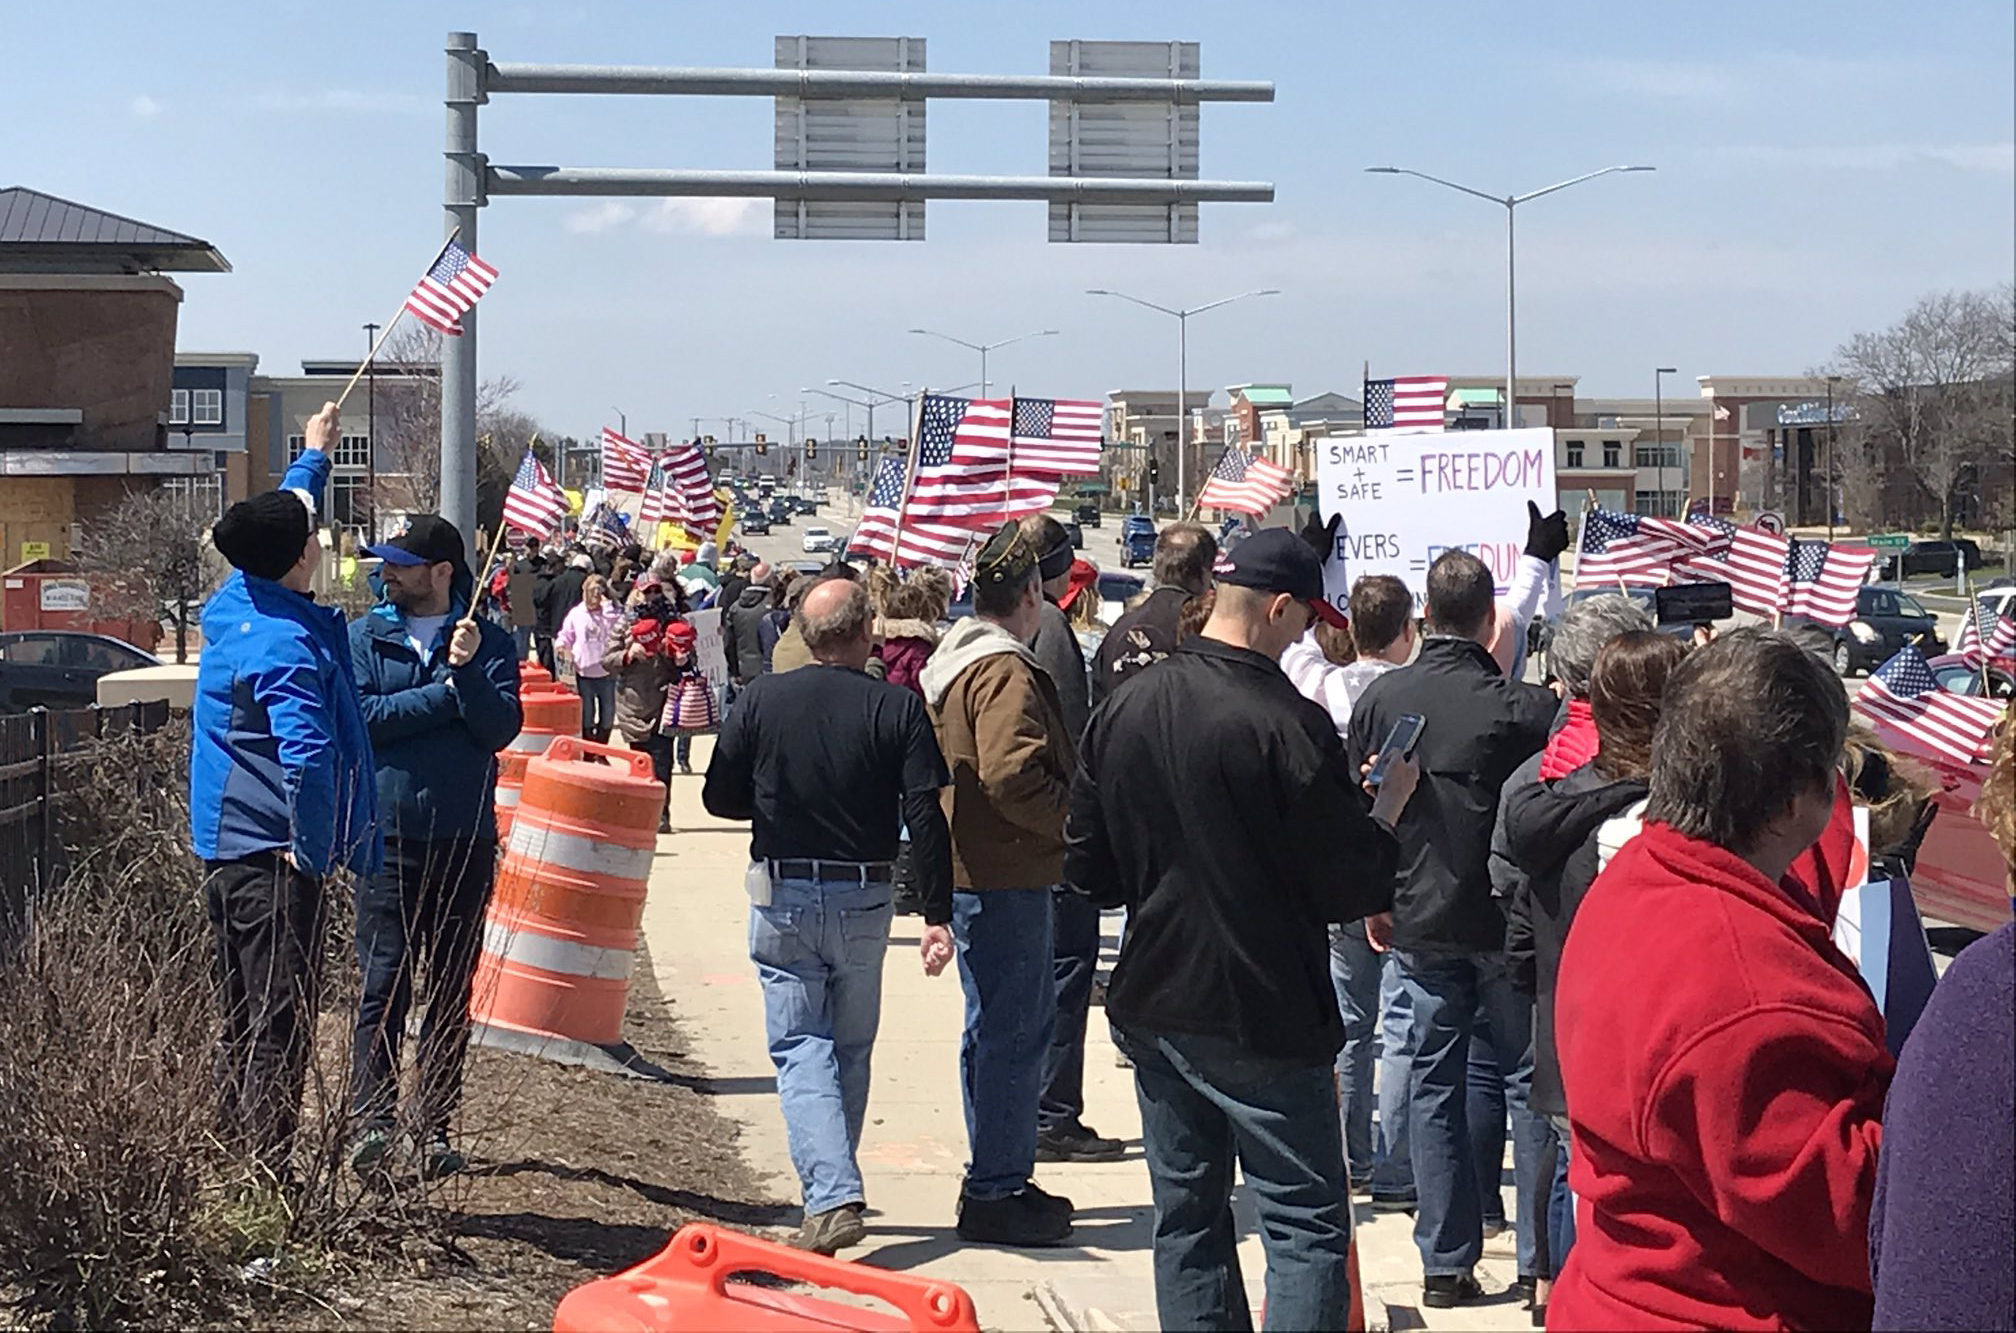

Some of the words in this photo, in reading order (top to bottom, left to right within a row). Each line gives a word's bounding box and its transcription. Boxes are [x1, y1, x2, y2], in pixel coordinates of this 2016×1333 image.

[1329, 444, 1390, 464] SMART
[1420, 449, 1543, 494] FREEDOM
[1337, 483, 1383, 500] SAFE
[1336, 533, 1401, 561] EVERS
